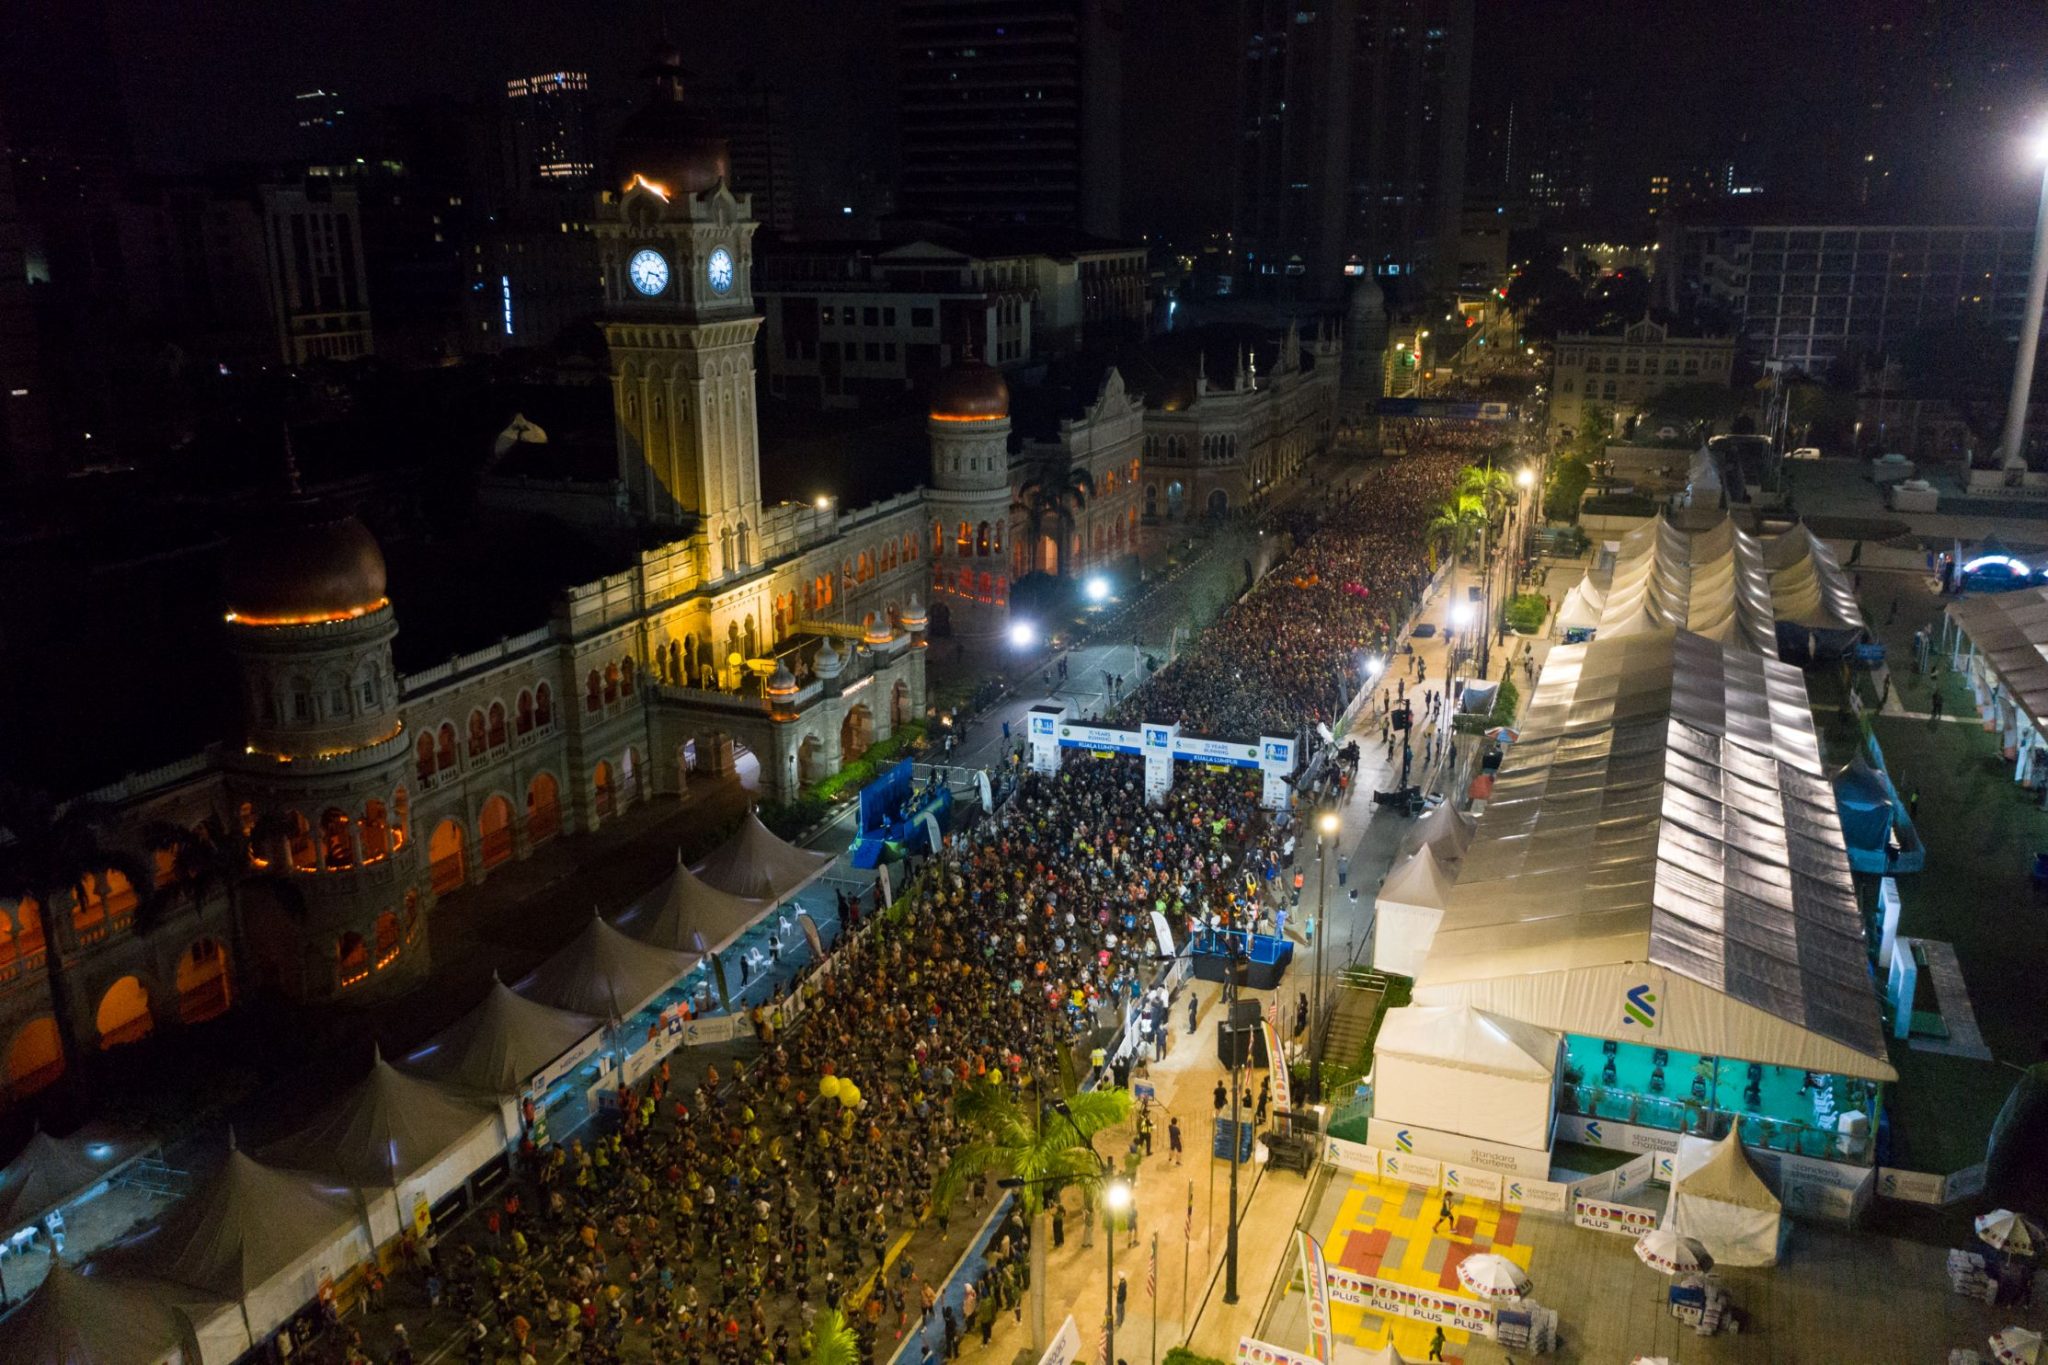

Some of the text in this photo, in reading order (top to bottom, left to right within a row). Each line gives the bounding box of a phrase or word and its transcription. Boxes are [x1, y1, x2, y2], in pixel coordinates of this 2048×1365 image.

[503, 276, 512, 334] HOTEL
[1098, 743, 1120, 751] LUMPUR
[1193, 755, 1238, 766] KUALA LUMPUR
[1632, 1134, 1678, 1148] standard
[1470, 1155, 1517, 1170] chartered
[1471, 1149, 1515, 1163] standard
[1581, 1217, 1610, 1229] PLUS
[1332, 1289, 1484, 1331] PLUS PLUS PLUS PLUS
